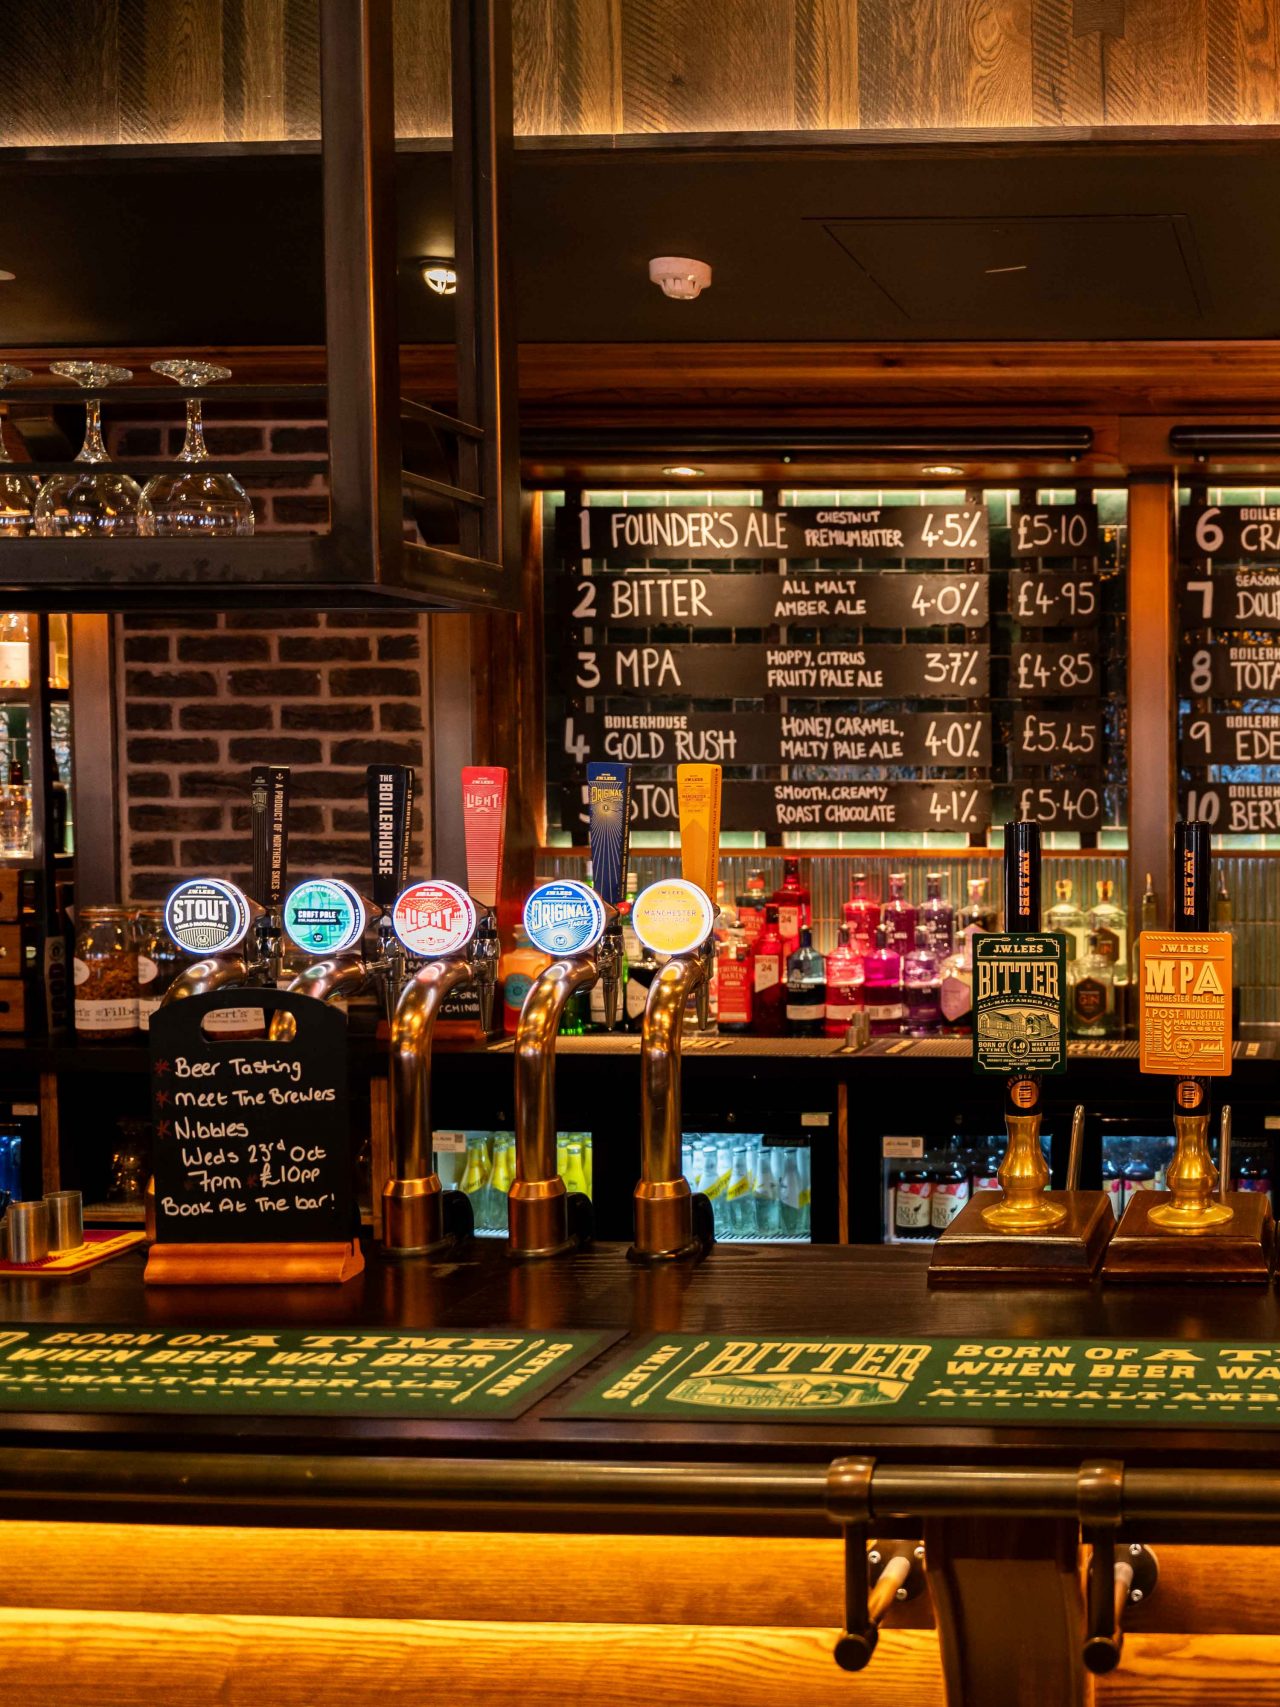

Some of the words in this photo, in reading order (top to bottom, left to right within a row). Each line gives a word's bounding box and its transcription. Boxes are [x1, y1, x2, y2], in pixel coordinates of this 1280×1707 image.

[816, 511, 880, 524] CHESTNUT
[1196, 508, 1223, 551] 6
[577, 511, 591, 550] 1
[610, 511, 738, 548] FOUNDER'S
[744, 512, 788, 549] ALE
[611, 579, 713, 619] BITTER
[782, 580, 809, 595] ALL
[815, 580, 856, 595] MALT
[572, 583, 596, 618] 2
[774, 600, 830, 616] AMBER
[834, 600, 866, 615] ALE
[1187, 582, 1213, 618] 7
[577, 652, 600, 688] 3
[615, 649, 681, 687] MPA
[817, 651, 865, 666] CITRUS
[767, 670, 816, 687] FRUITY
[819, 671, 854, 687] PALE
[856, 671, 883, 687] ALE
[1190, 650, 1211, 693] 8
[605, 716, 687, 730] BOILERHOUSE
[605, 731, 663, 763] GOLD
[675, 731, 737, 762] RUSH
[1190, 721, 1212, 754] 9
[780, 741, 828, 761] MALTY
[833, 741, 865, 759] PALE
[869, 740, 903, 760] ALE
[274, 791, 283, 821] PRODUCT
[831, 787, 887, 805] CREAMY
[777, 806, 823, 823] ROAST
[827, 805, 895, 822] CHOCOLATE
[273, 824, 282, 832] OF
[379, 784, 393, 874] BOILERHOUSE
[272, 835, 282, 869] NORTHERN
[272, 871, 280, 889] SKIES
[173, 900, 229, 924] STOUT
[406, 908, 452, 933] LIGHT
[531, 901, 590, 929] ORIGINAL
[977, 961, 1060, 1000] BITTER
[1145, 960, 1224, 994] MPA
[1145, 994, 1189, 1002] MANCHESTER
[1193, 995, 1209, 1003] PALE
[175, 1057, 220, 1077] Beer
[229, 1058, 301, 1081] Tasting
[269, 1088, 335, 1102] Brewers
[175, 1116, 248, 1140] Nibbles
[182, 1148, 239, 1166] Weds
[290, 1147, 326, 1161] Oct
[691, 1341, 932, 1381] BITTER
[952, 1343, 1071, 1360] BORN
[1083, 1347, 1139, 1361] OF
[945, 1361, 1076, 1378] WHEN
[1087, 1363, 1196, 1380] BEER
